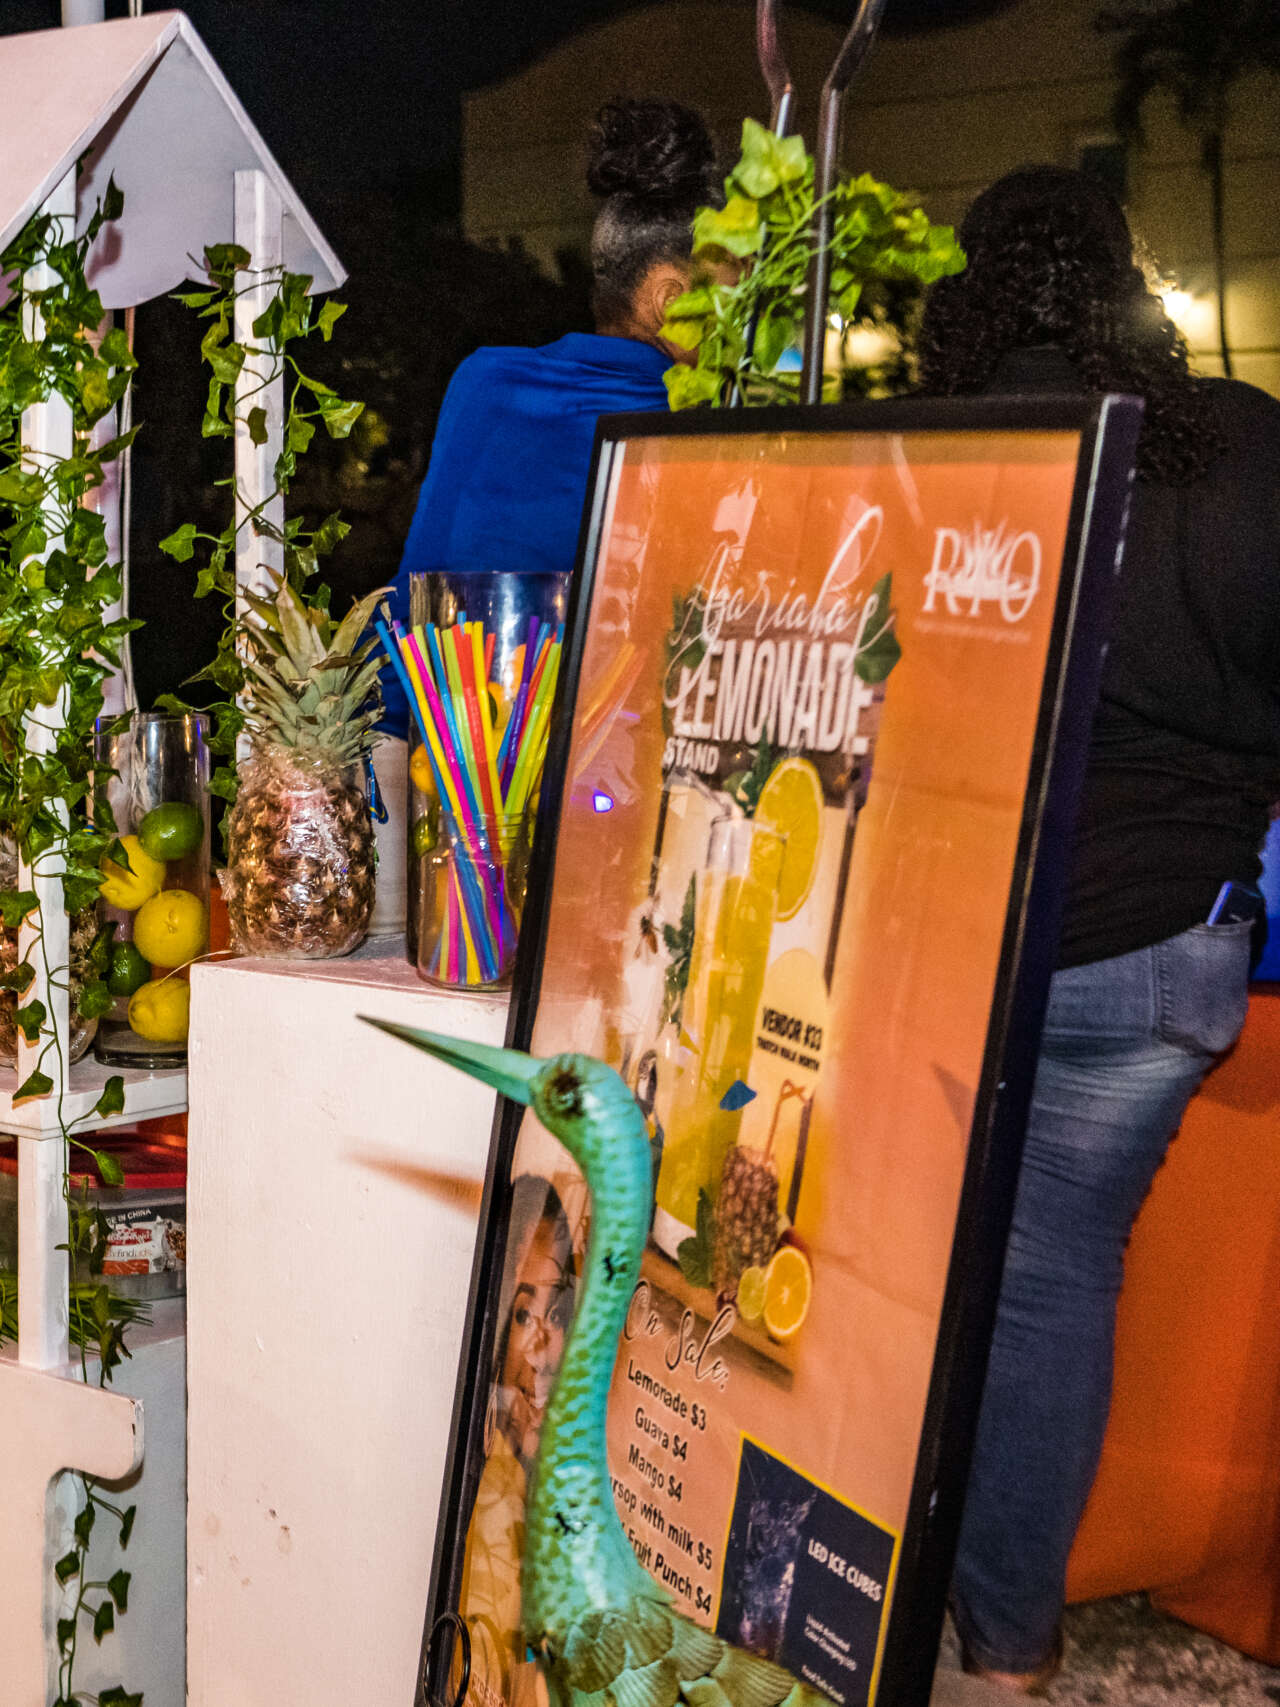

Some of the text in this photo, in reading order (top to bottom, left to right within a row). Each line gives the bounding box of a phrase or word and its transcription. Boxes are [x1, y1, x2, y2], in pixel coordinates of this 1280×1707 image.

[673, 637, 874, 755] LEMONADE
[662, 736, 721, 775] STAND
[762, 1006, 802, 1042] VENDOR
[127, 1209, 152, 1219] CHINA
[623, 1279, 662, 1342] On
[627, 1358, 707, 1432] Lemonade $3
[634, 1406, 688, 1462] Guava $4
[628, 1443, 683, 1503] Mango $4
[640, 1501, 665, 1533] with
[667, 1522, 694, 1557] milk
[696, 1541, 713, 1571] $5
[653, 1552, 693, 1600] Punch
[694, 1585, 713, 1616] $4
[808, 1538, 883, 1602] LED ICE CUBES
